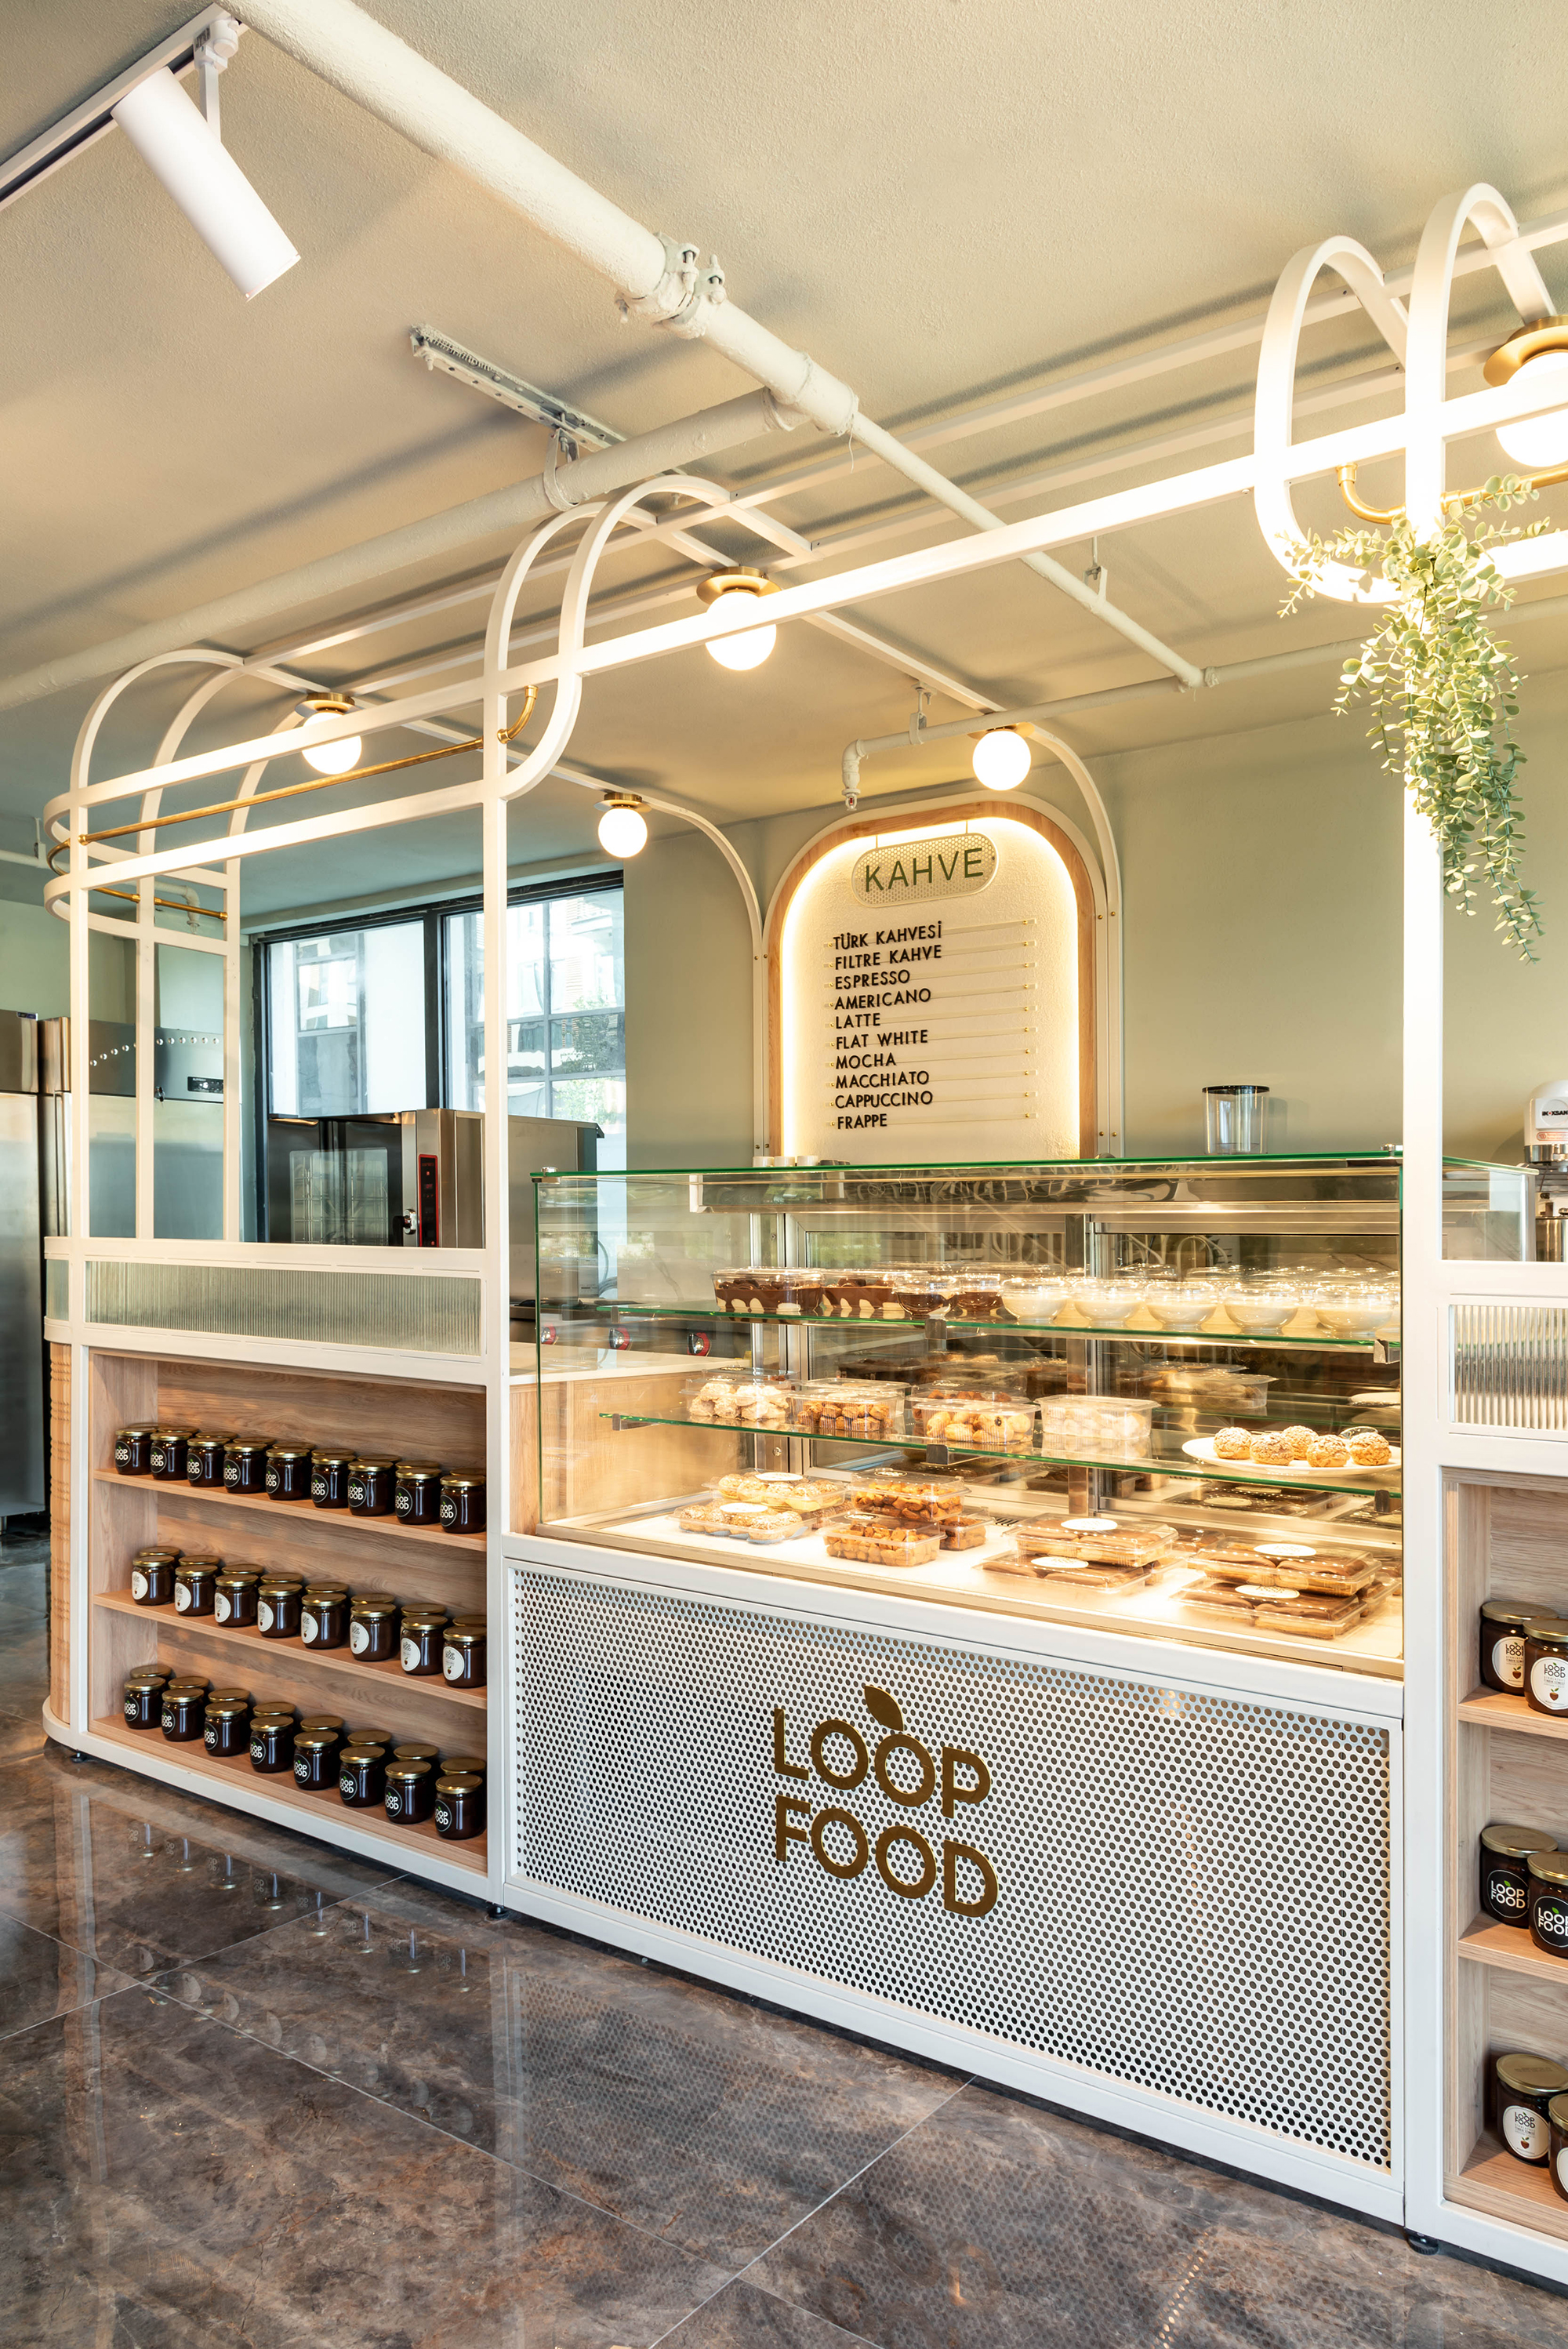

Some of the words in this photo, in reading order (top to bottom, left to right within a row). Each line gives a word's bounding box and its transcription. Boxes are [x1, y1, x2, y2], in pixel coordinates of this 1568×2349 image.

[866, 847, 984, 893] KAHVE
[833, 931, 869, 950] TÜRK
[876, 920, 942, 946] KAHVESİ
[835, 951, 880, 971] FILTRE
[889, 944, 942, 964] KAHVE
[835, 969, 911, 990] ESPRESSO
[834, 988, 932, 1011] AMERICANO
[836, 1012, 881, 1029] LATTE
[836, 1033, 869, 1050] FLAT
[877, 1029, 928, 1047] WHITE
[835, 1052, 897, 1069] MOCHA
[835, 1070, 930, 1089] MACCHIATO
[835, 1090, 934, 1109] CAPPUCCINO
[837, 1113, 887, 1130] FRAPPE
[1544, 1668, 1566, 1678] FOOD
[774, 1708, 991, 1818] LOOP
[775, 1794, 999, 1918] FOOD
[1491, 1880, 1525, 1898] LOOP
[1491, 1890, 1526, 1908] FOOD
